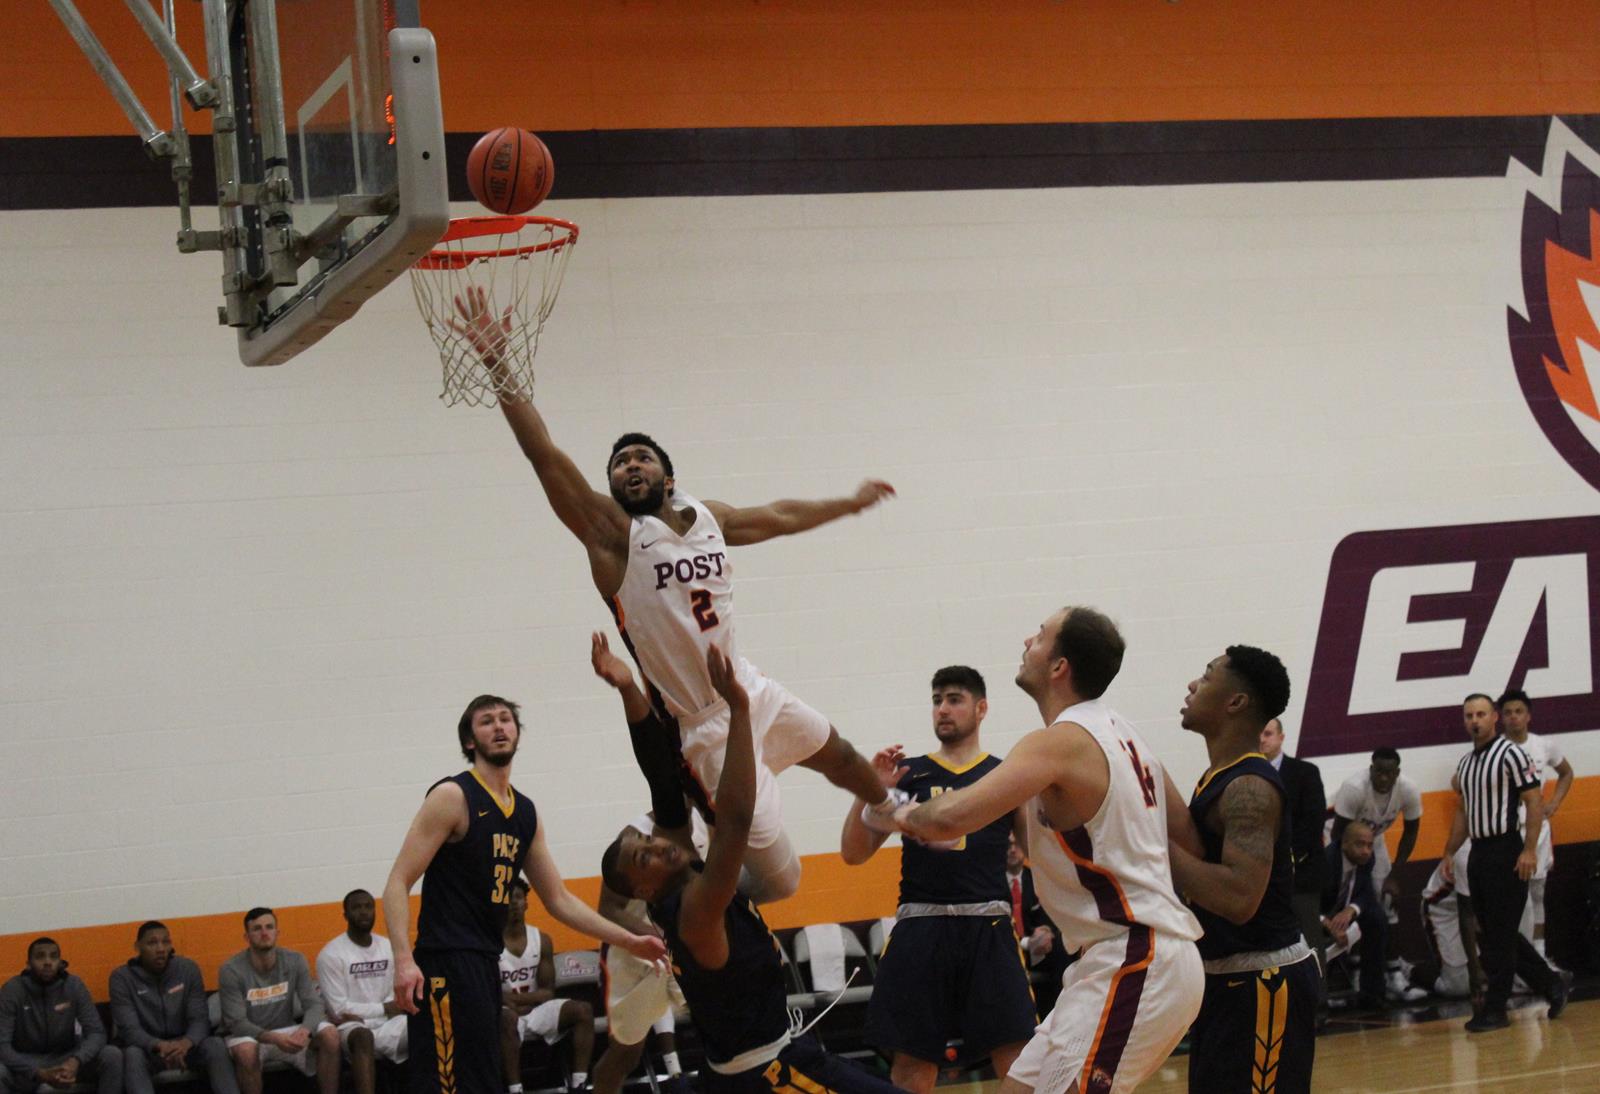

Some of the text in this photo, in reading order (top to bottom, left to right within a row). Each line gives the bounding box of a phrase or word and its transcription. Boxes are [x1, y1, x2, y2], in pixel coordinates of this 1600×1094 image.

[653, 552, 725, 591] POST
[689, 588, 720, 634] 2
[501, 965, 538, 984] POST
